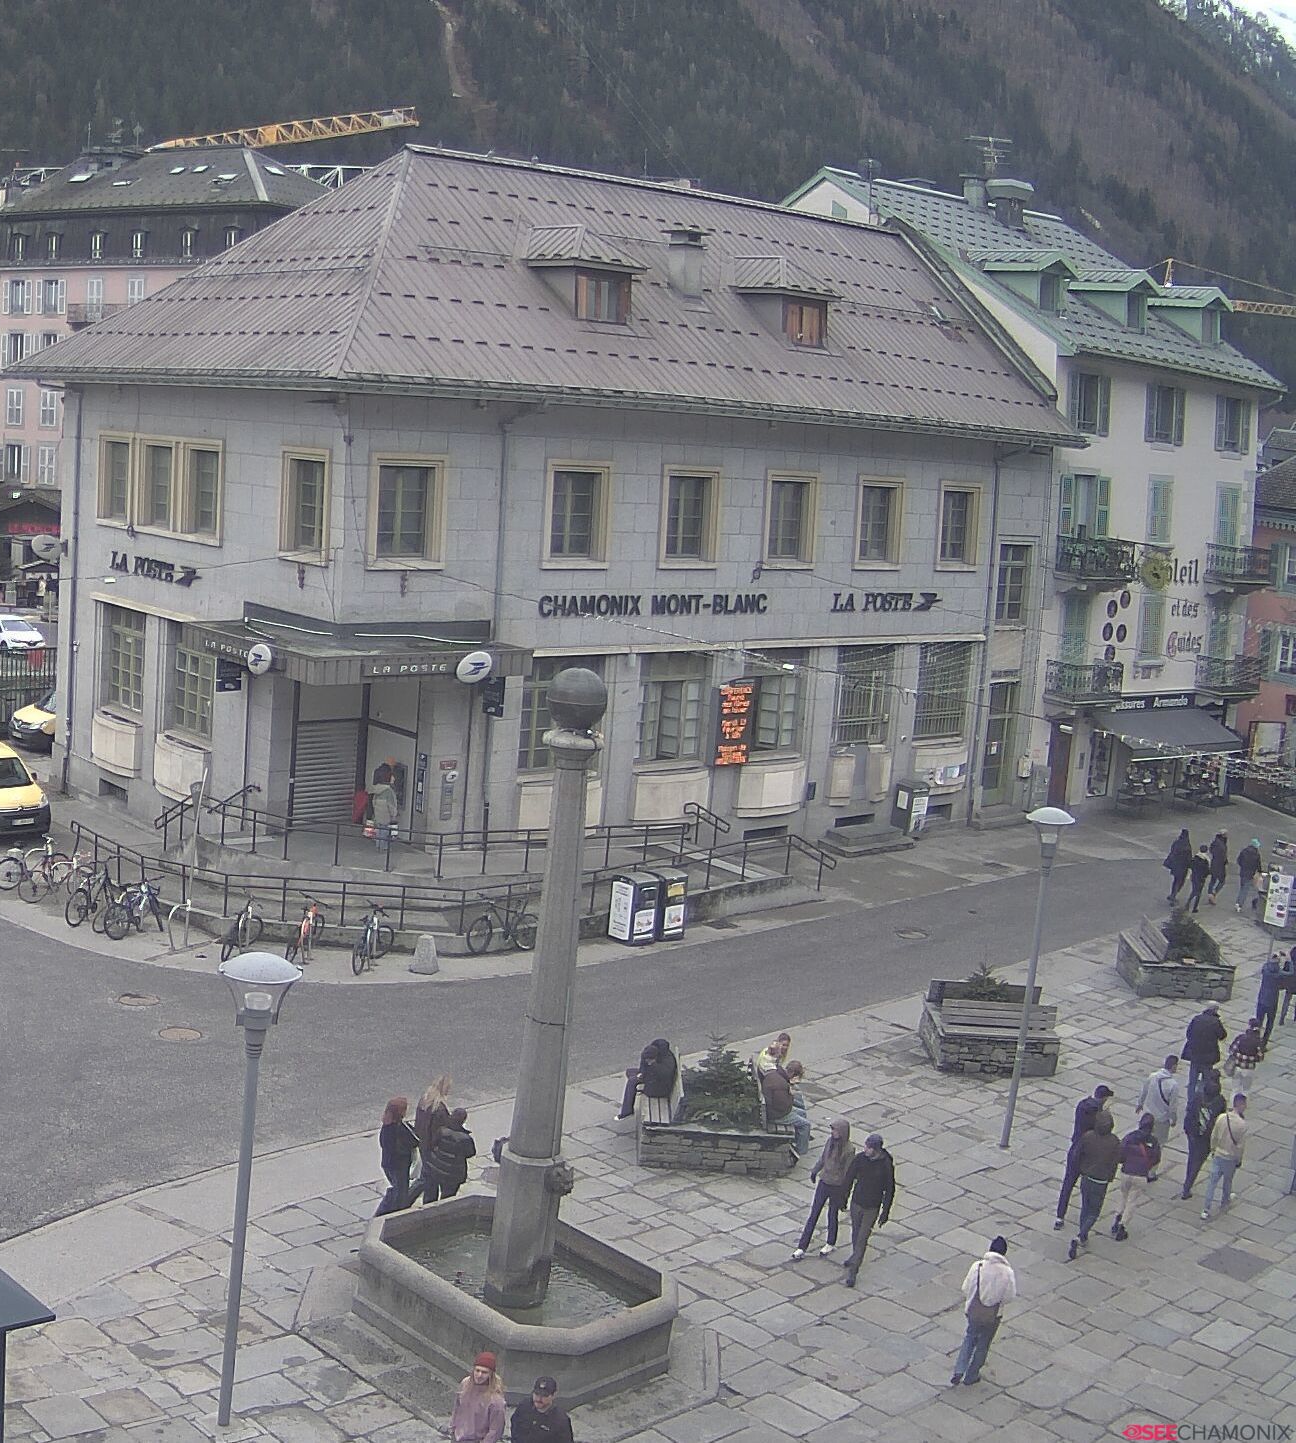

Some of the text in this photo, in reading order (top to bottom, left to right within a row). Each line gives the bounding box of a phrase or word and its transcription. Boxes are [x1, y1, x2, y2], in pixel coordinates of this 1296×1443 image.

[109, 551, 175, 583] LA POSTE
[538, 593, 768, 618] CHAMONIX MONT-BLANC
[831, 592, 914, 612] LA POSTE
[205, 640, 216, 648] LA
[373, 664, 447, 674] LA POSTE
